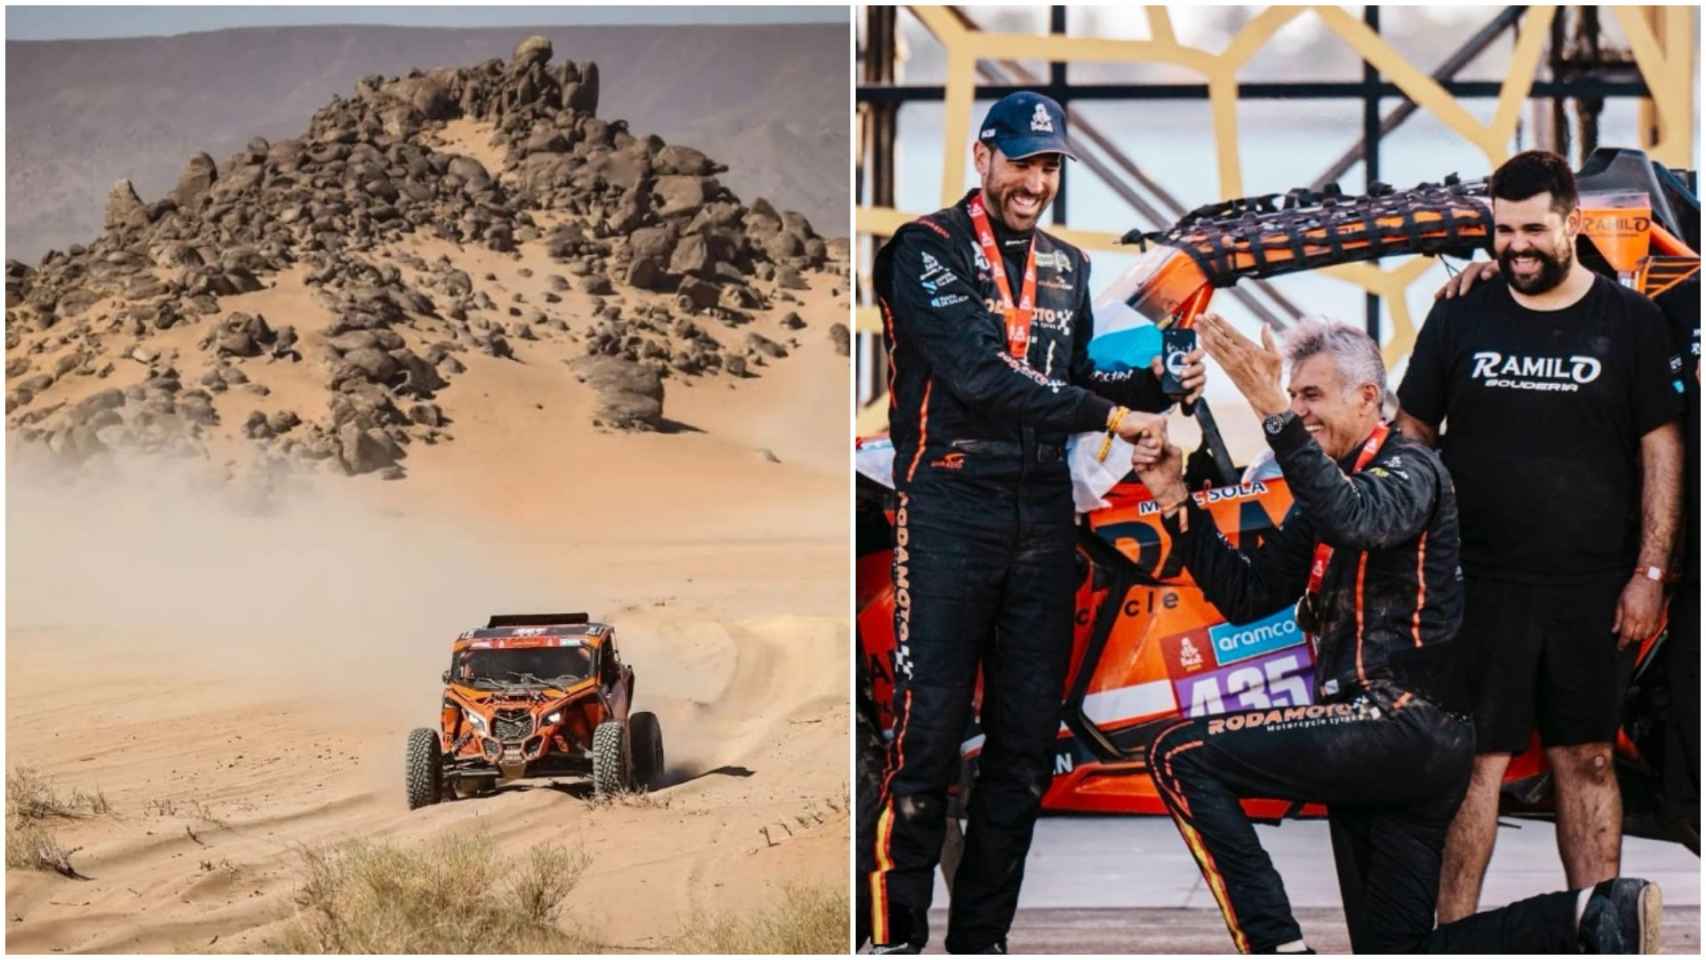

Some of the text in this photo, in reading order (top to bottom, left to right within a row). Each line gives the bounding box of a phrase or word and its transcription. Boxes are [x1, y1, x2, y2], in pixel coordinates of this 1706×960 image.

[1471, 351, 1602, 384] RAMILO
[1208, 479, 1267, 502] SOLA
[1218, 619, 1297, 651] aramco
[1207, 702, 1352, 735] RODAMOTO
[1266, 718, 1327, 732] Motorcycle
